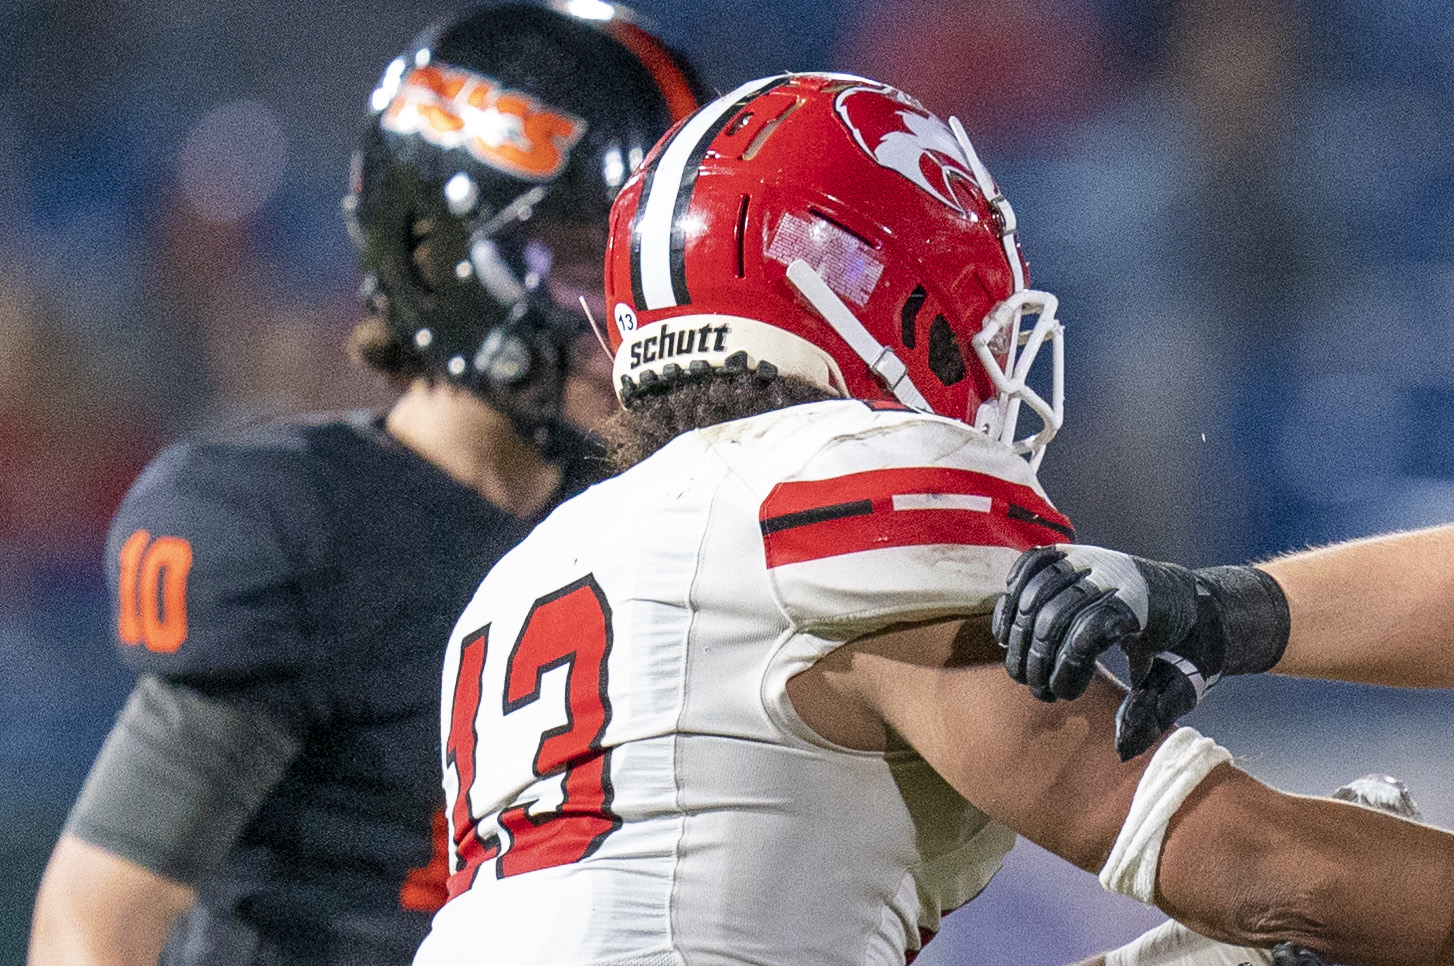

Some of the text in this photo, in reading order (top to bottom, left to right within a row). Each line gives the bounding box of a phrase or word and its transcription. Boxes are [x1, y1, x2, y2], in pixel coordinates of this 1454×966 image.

[618, 313, 635, 331] 13
[630, 323, 730, 369] schutt
[119, 529, 193, 654] 10
[446, 572, 624, 900] 13
